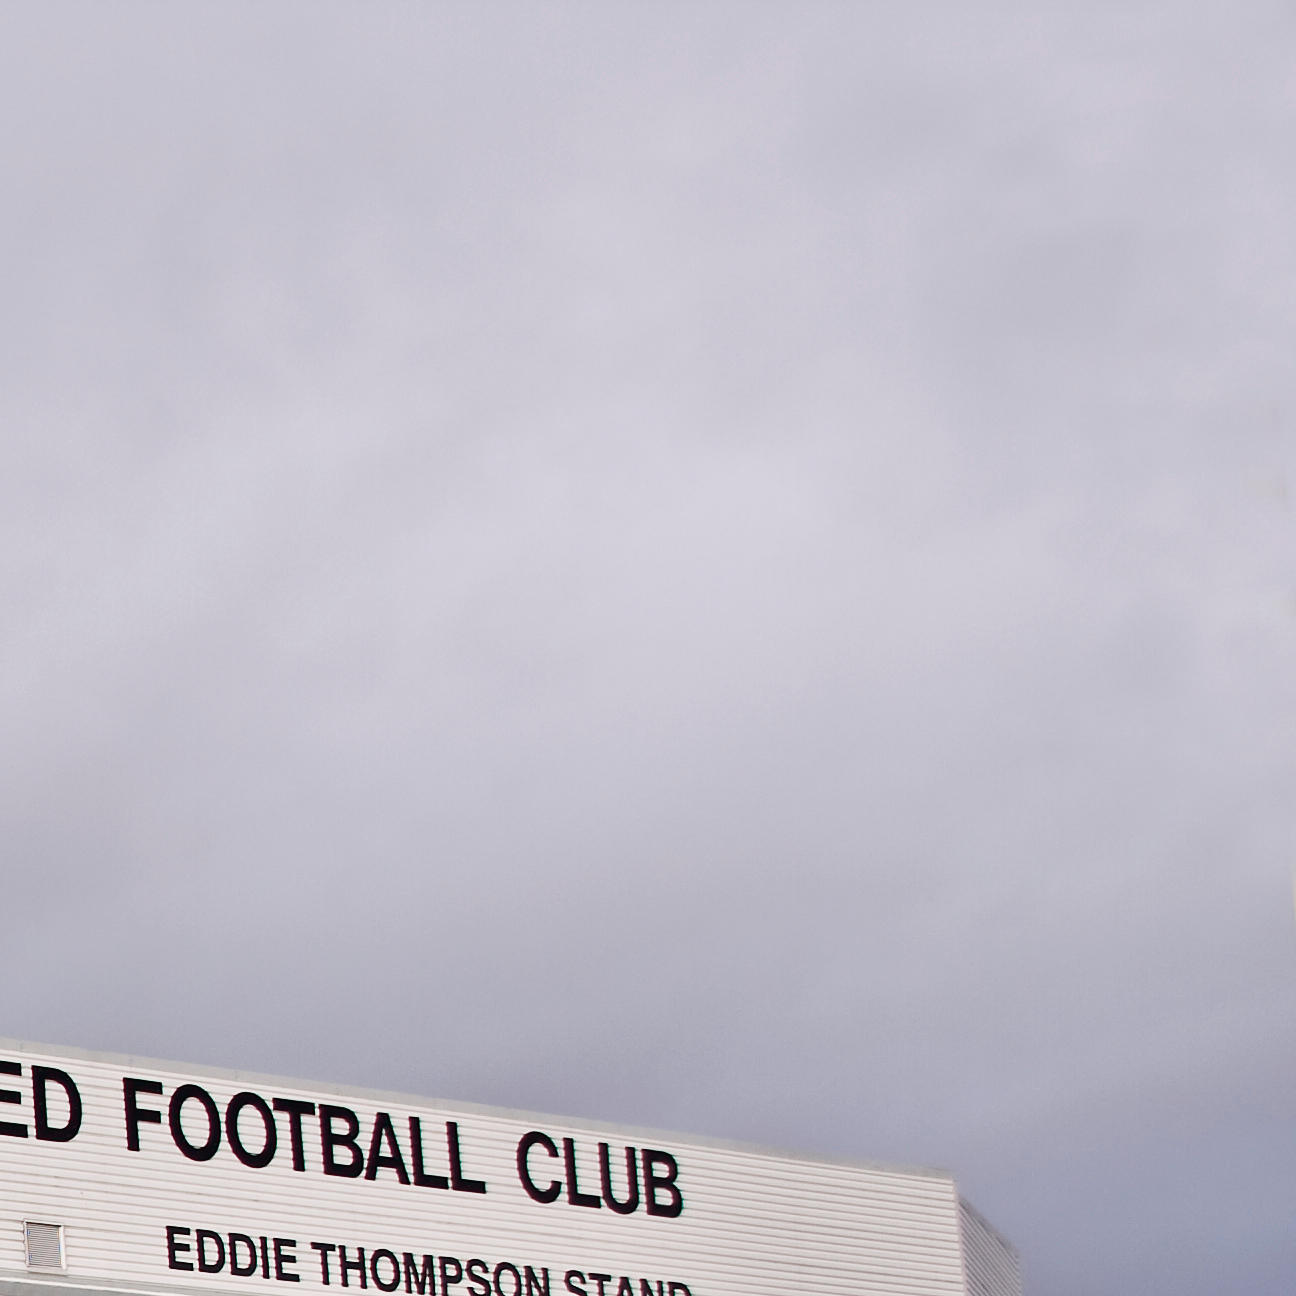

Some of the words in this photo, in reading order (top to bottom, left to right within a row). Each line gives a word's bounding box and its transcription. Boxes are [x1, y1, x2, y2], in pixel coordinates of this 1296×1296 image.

[122, 1076, 487, 1195] FOOTBALL
[515, 1130, 684, 1219] CLUB
[165, 1225, 301, 1283] EDDIE
